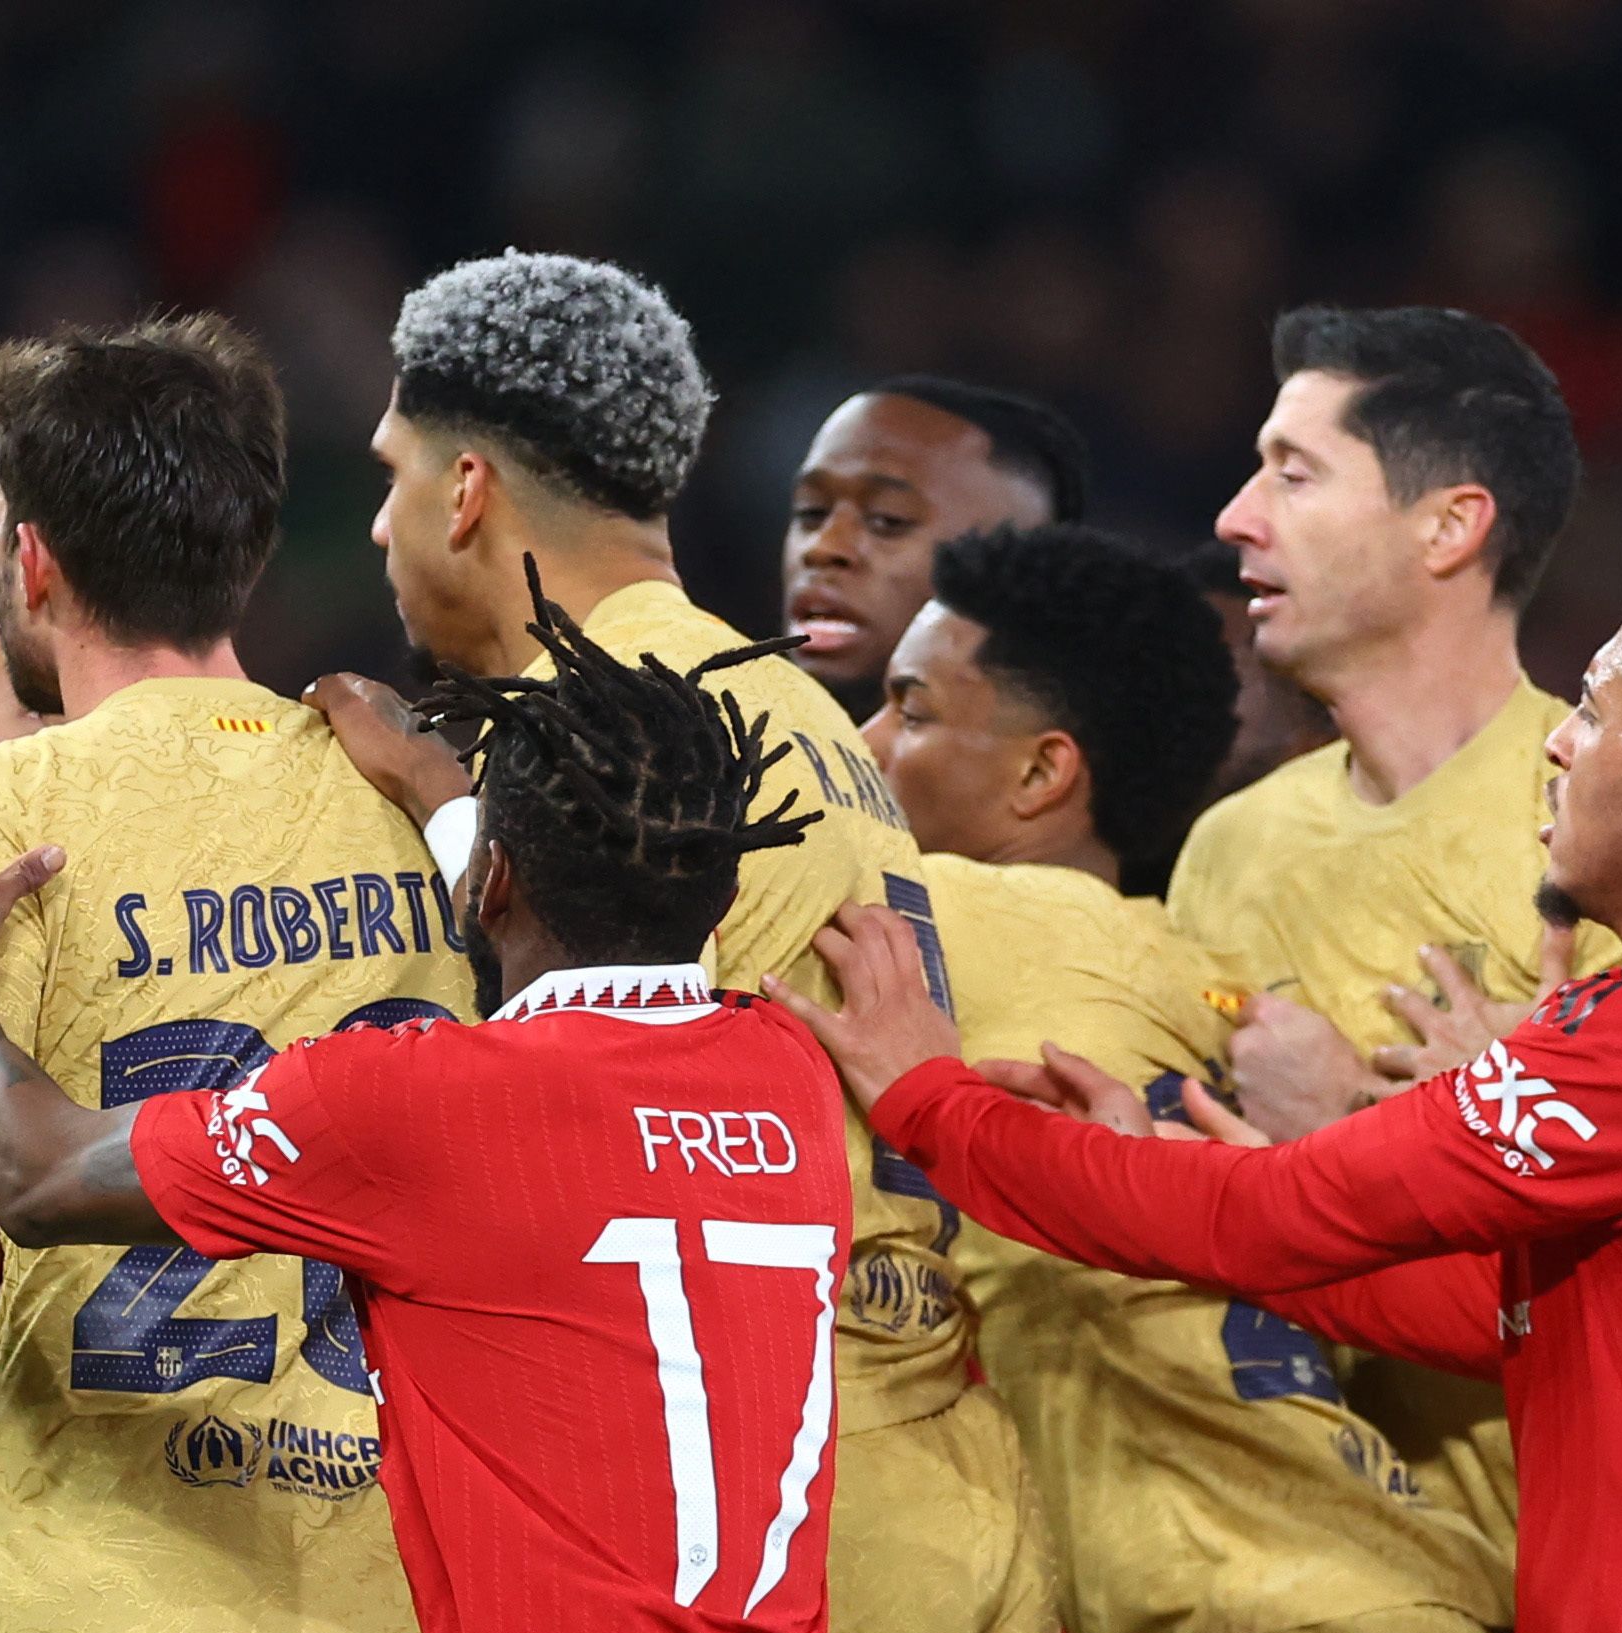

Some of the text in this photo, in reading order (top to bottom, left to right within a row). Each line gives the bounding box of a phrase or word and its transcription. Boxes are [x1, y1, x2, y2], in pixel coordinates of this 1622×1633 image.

[114, 893, 174, 979] S.
[633, 1106, 798, 1179] FRED
[581, 1216, 837, 1621] 17
